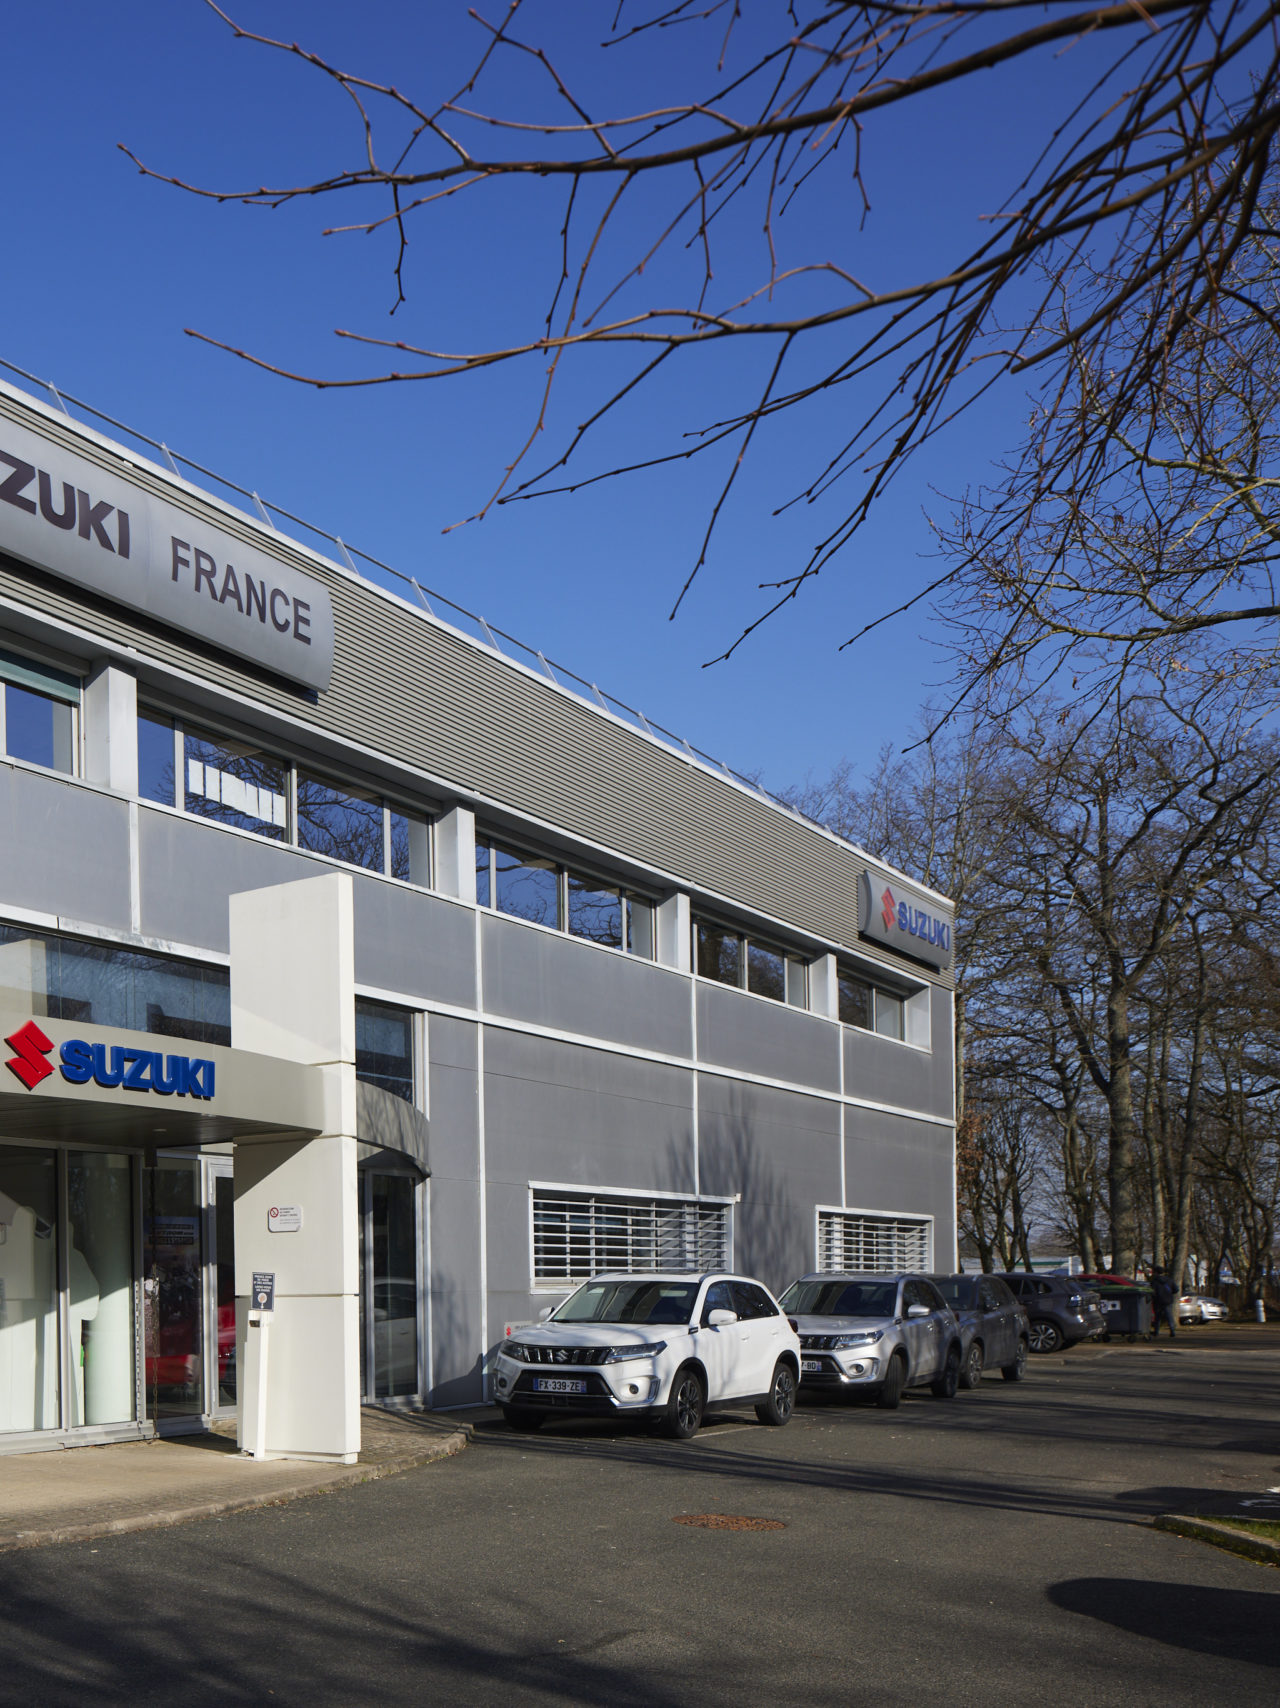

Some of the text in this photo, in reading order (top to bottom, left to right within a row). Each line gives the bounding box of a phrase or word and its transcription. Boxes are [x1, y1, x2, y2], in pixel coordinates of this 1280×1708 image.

[170, 535, 313, 646] FRANCE
[897, 901, 950, 952] SUZUKI
[59, 1039, 216, 1101] SUZUKI
[538, 1379, 581, 1392] FX-339-ZE
